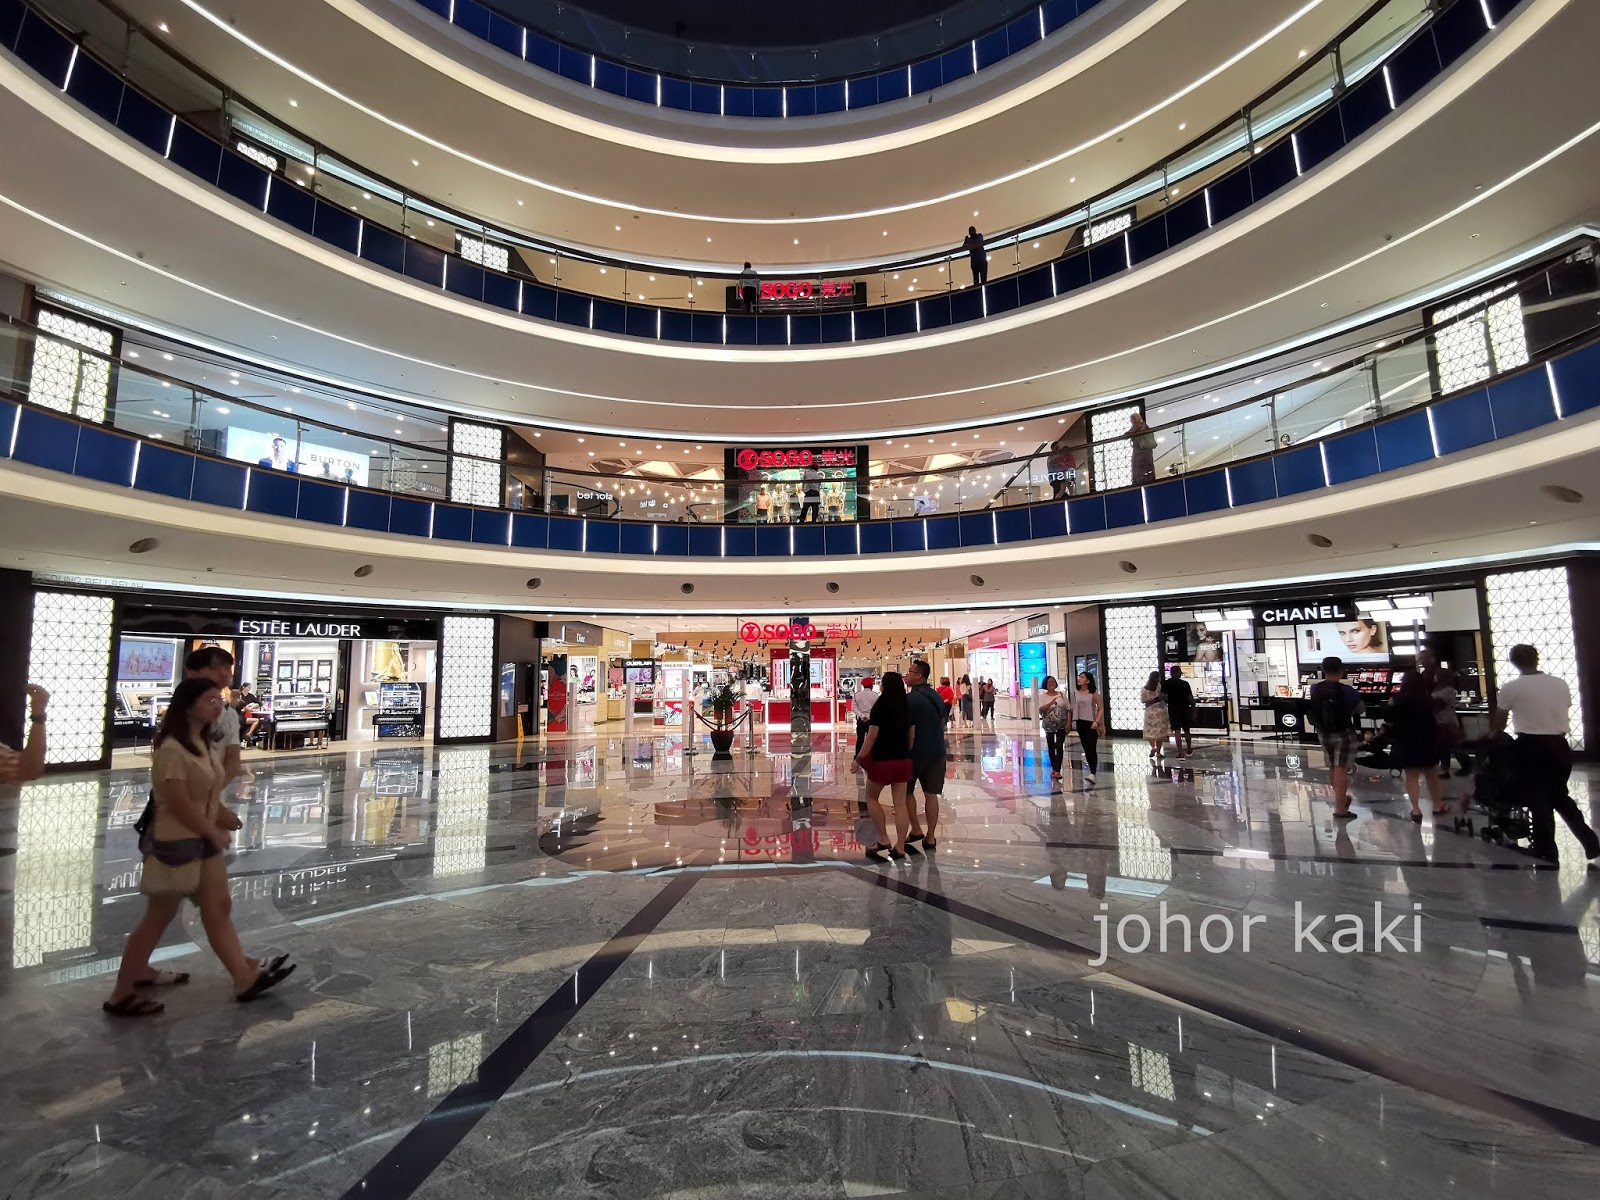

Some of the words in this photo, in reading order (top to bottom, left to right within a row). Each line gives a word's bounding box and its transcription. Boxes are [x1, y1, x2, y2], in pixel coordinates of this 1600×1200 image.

[760, 281, 813, 299] SOGO
[310, 453, 360, 470] BURTON
[760, 449, 813, 467] SOGO
[1261, 605, 1346, 623] CHANEL
[295, 622, 361, 637] LAUDER
[763, 623, 818, 640] SOGO
[826, 623, 860, 639] 崇光
